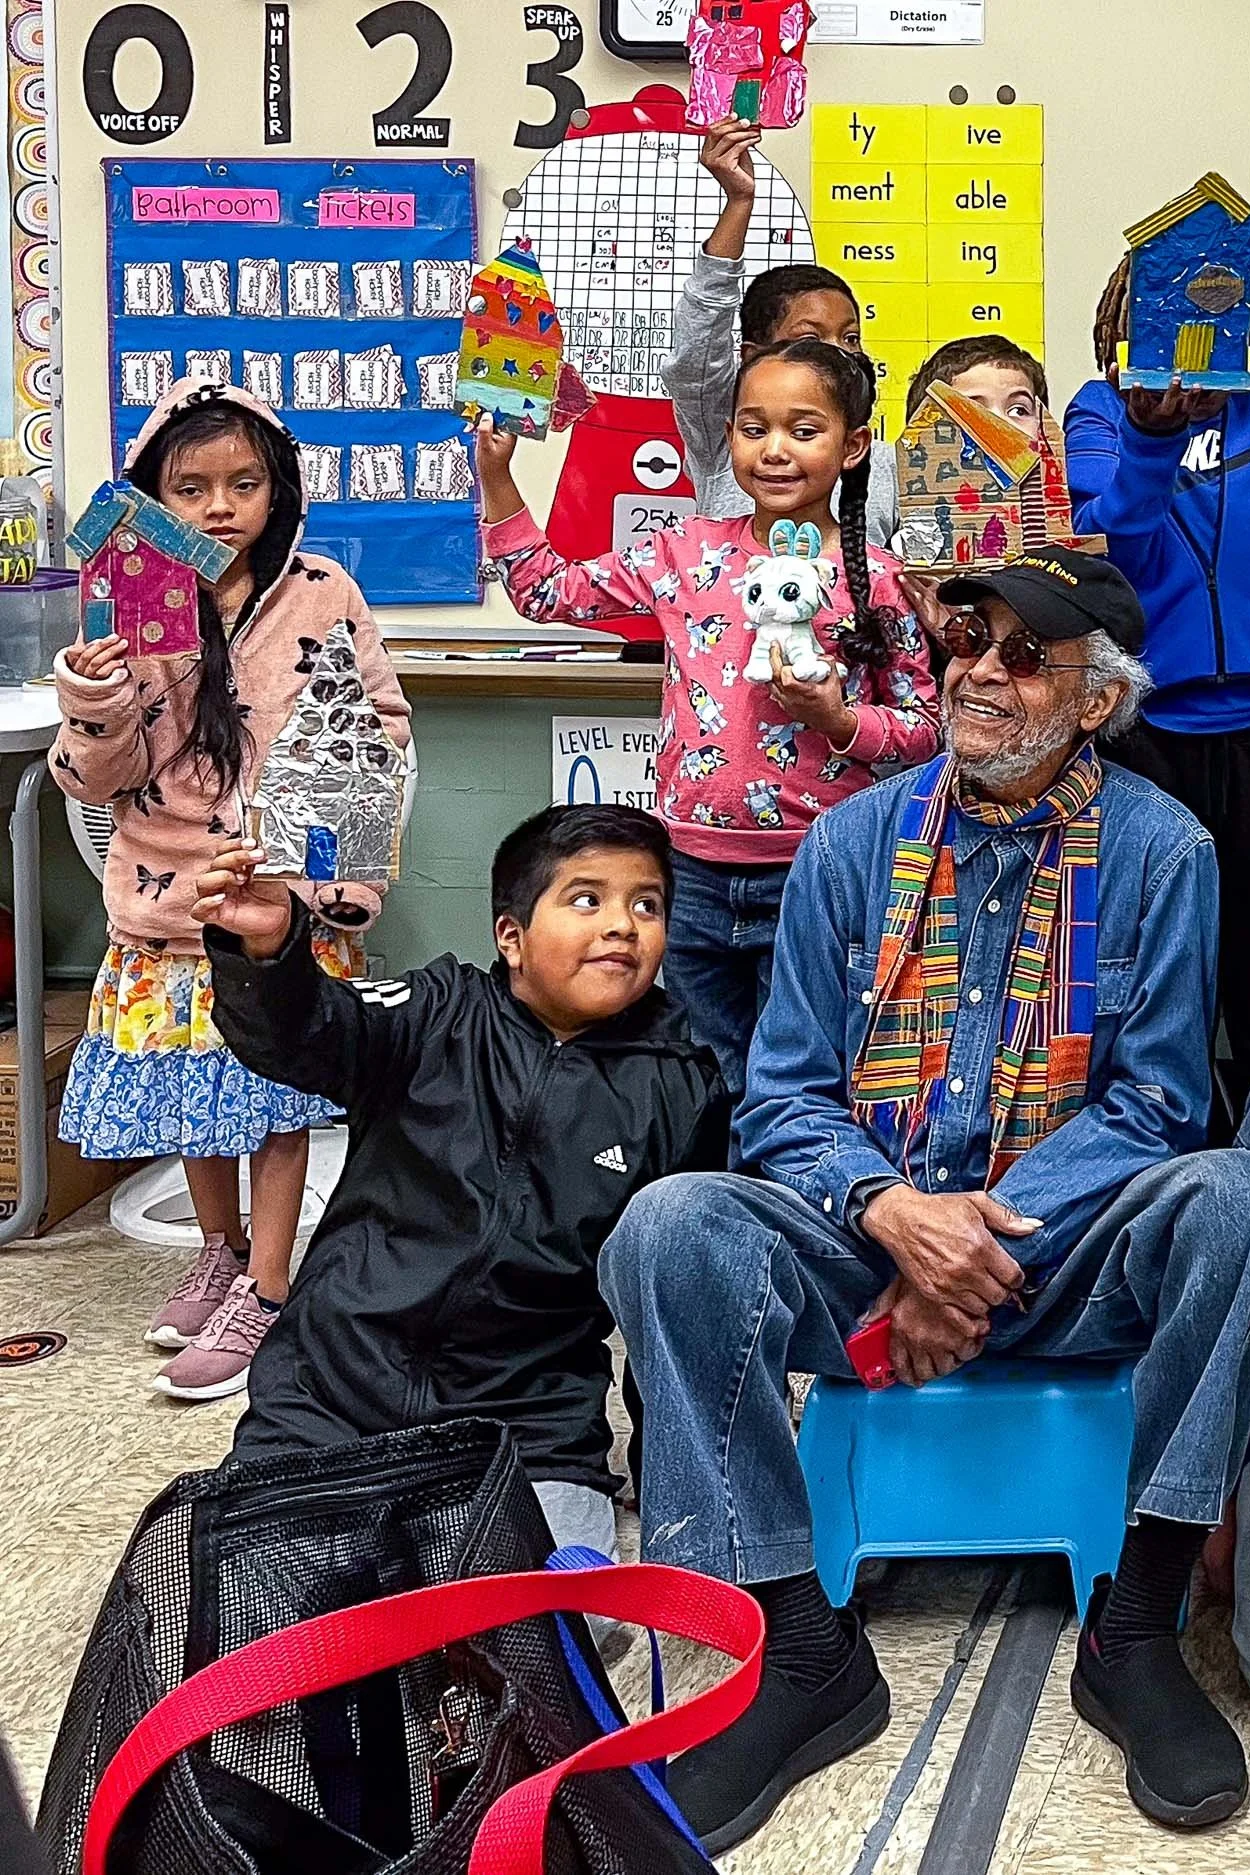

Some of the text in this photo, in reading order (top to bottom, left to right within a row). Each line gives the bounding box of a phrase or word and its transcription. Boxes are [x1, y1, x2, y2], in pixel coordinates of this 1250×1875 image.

[527, 7, 576, 27] SPEAK
[657, 11, 672, 26] 25
[891, 11, 946, 21] Dictation
[557, 26, 580, 43] UP
[82, 4, 195, 145] 0
[269, 13, 284, 135] WHISPER
[355, 1, 453, 147] 2
[513, 4, 586, 149] 3
[100, 113, 179, 133] VOICE OFF
[377, 124, 444, 141] NORMAL
[849, 112, 875, 154] ty
[968, 125, 1001, 144] ive
[832, 172, 894, 200] ment
[956, 180, 1006, 209] able
[136, 192, 410, 222] Bathroom Tickets
[844, 245, 894, 259] ness
[963, 242, 996, 274] ing
[972, 306, 1000, 320] en
[878, 362, 888, 378] s
[630, 507, 683, 534] 25¢
[558, 726, 614, 755] LEVEL
[205, 1283, 247, 1338] NAUTICA
